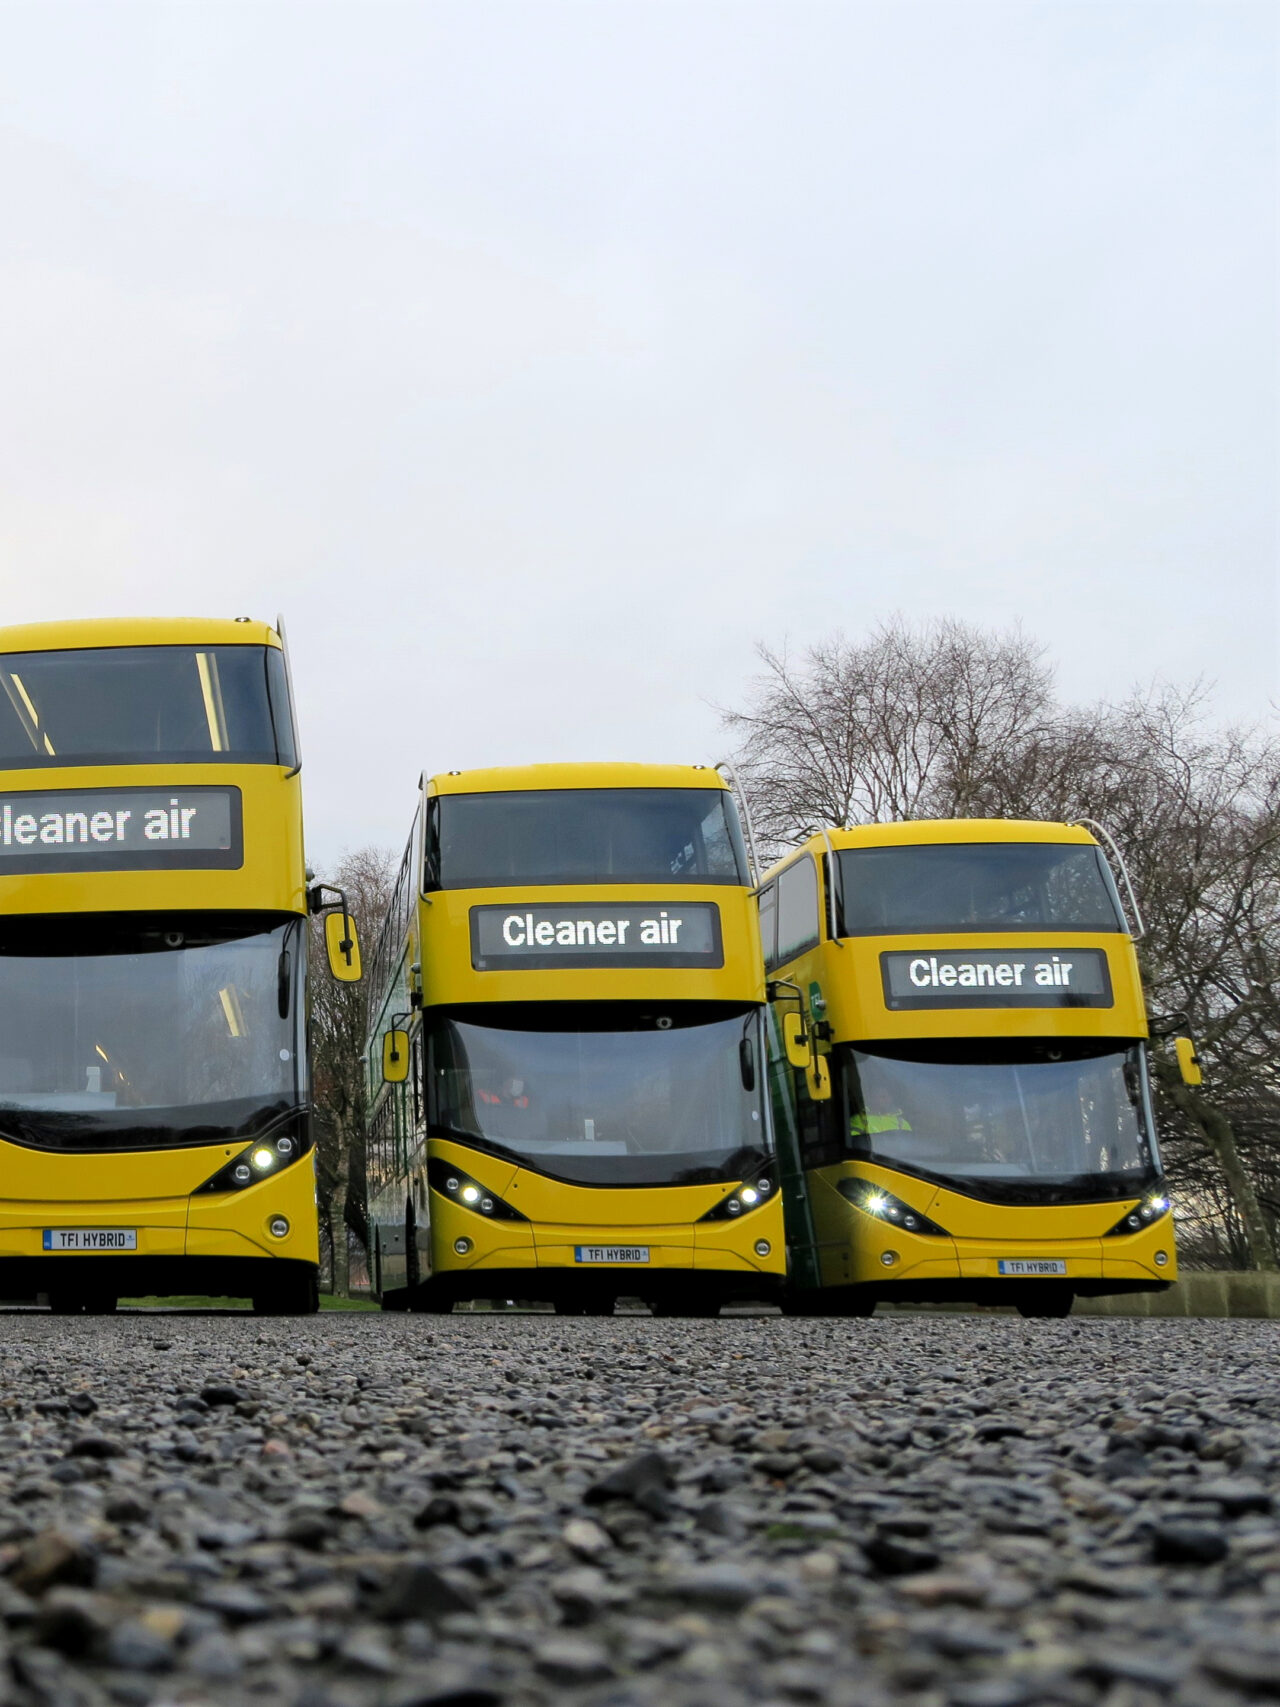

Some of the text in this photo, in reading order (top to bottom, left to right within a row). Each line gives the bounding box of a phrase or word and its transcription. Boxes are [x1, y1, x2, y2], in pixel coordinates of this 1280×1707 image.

[144, 798, 197, 840] air
[502, 911, 683, 946] Cleaner air
[909, 956, 1073, 987] Cleaner air
[60, 1232, 78, 1247] TFI
[83, 1232, 125, 1247] HYBRID
[588, 1248, 641, 1260] TFI HYBRID
[1010, 1262, 1058, 1273] TFI HYBRID
